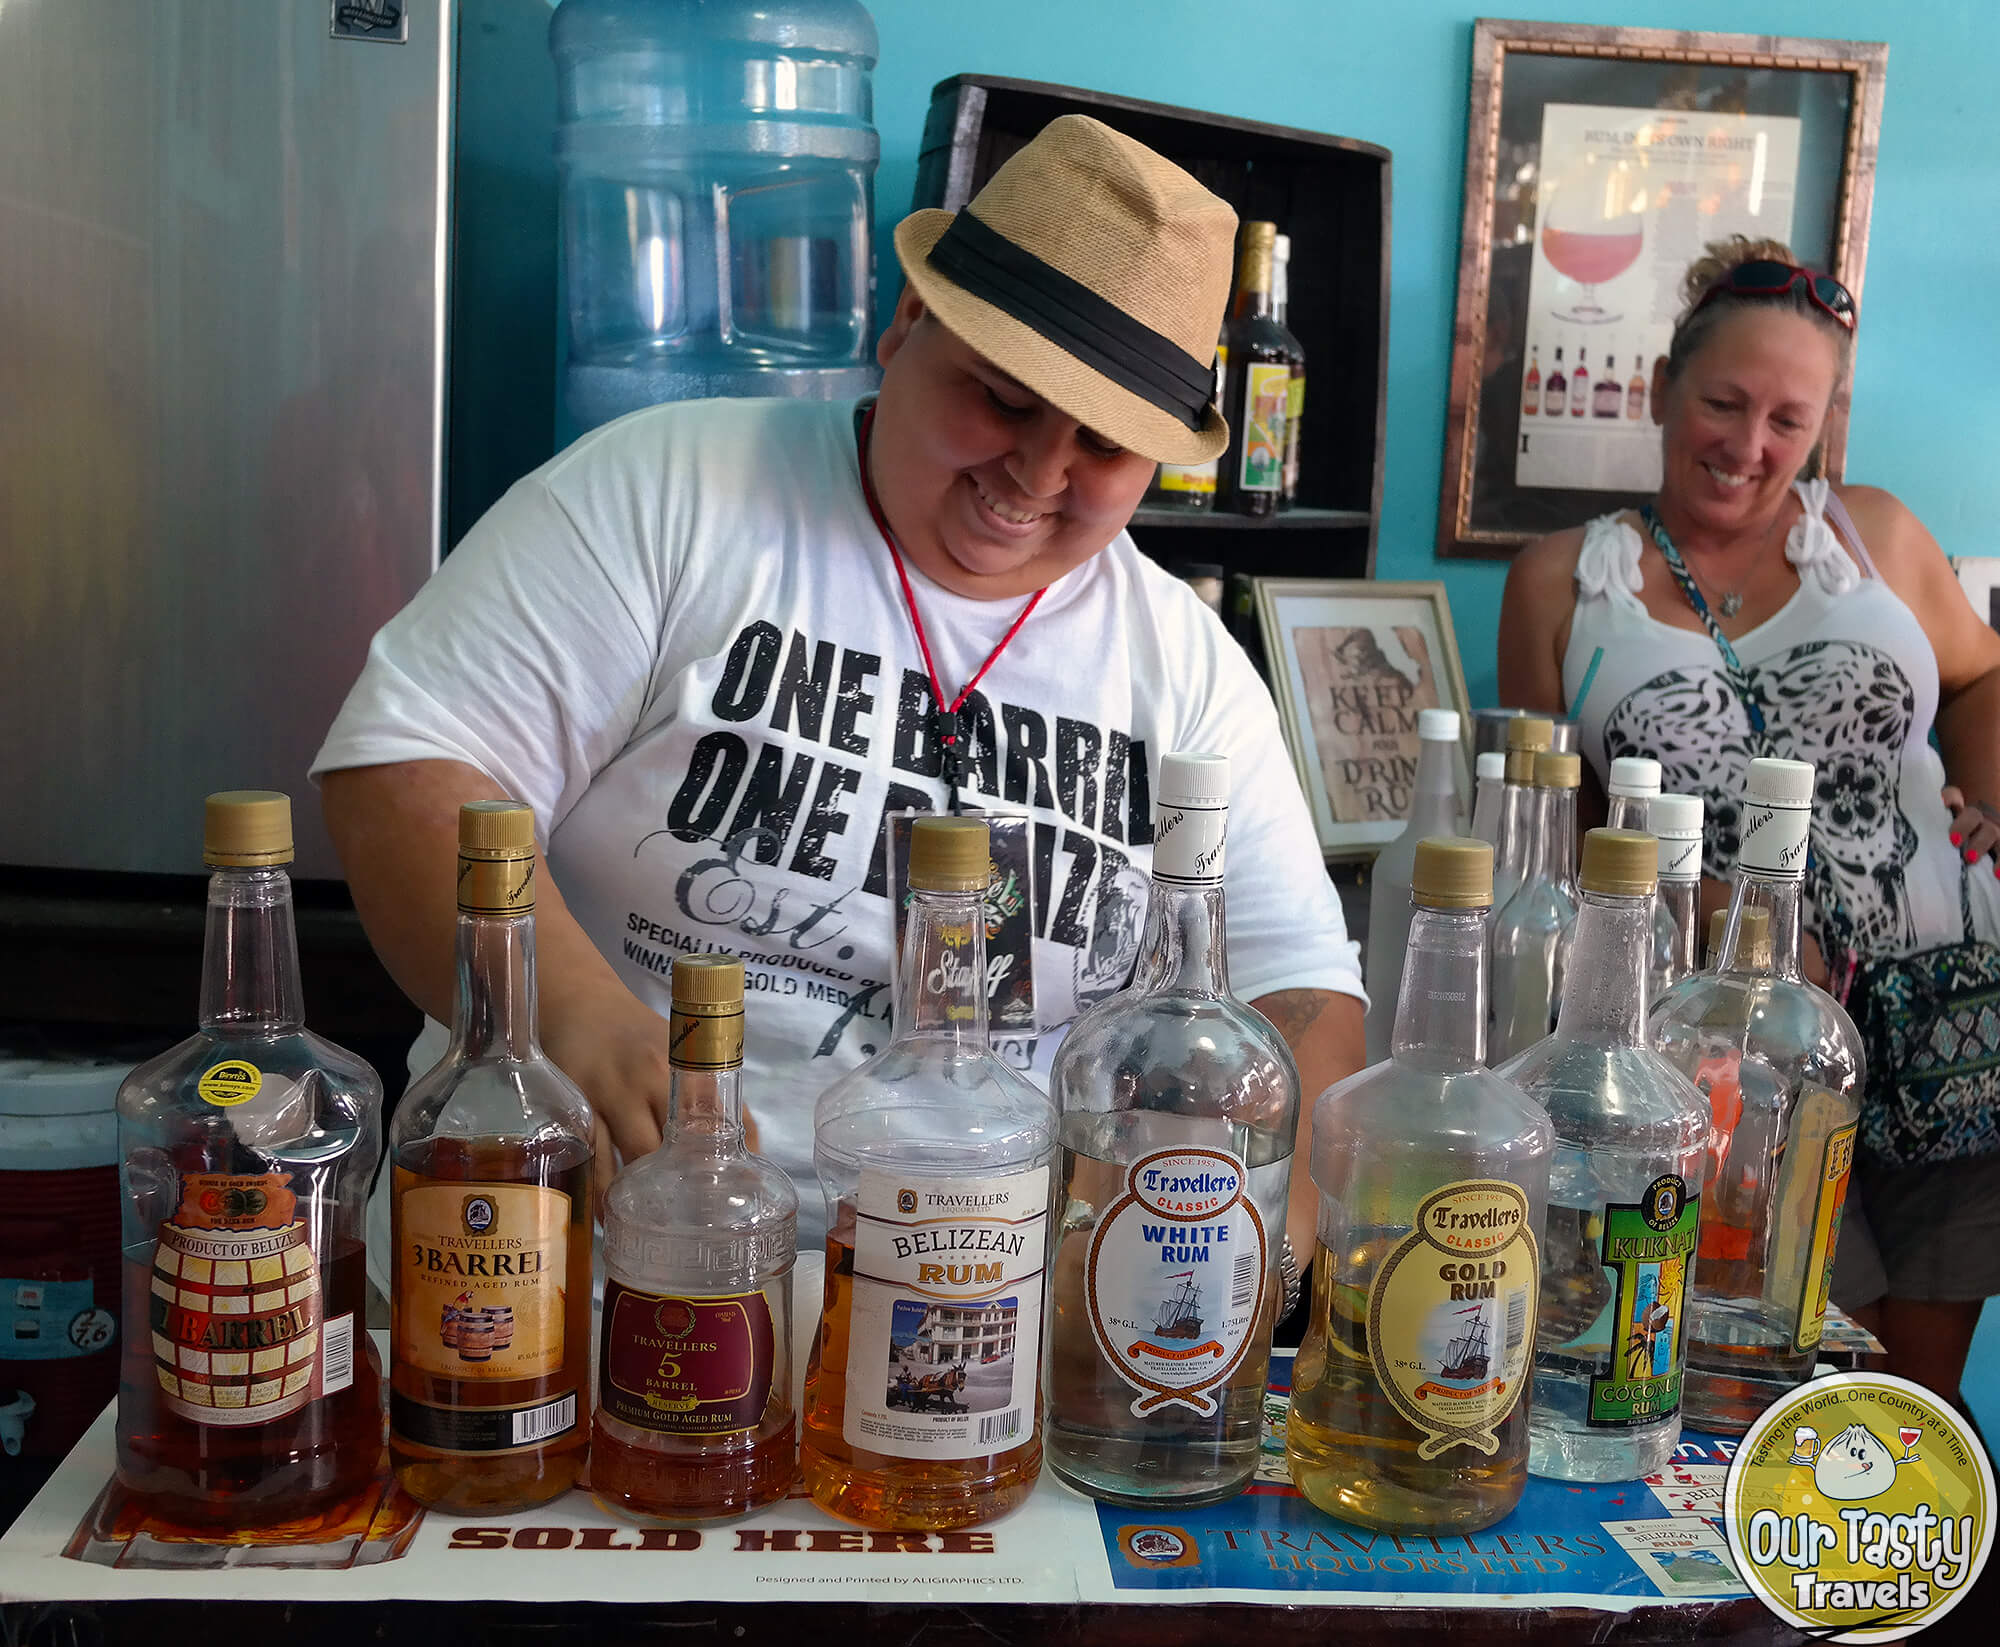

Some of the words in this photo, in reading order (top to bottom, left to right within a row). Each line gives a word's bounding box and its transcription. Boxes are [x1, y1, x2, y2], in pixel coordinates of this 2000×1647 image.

[711, 619, 881, 757] ONE
[1329, 685, 1414, 710] KEEP
[1334, 707, 1419, 735] CALM
[1336, 757, 1419, 786] DRIN
[667, 731, 863, 882] ONE
[1354, 784, 1411, 820] RU
[738, 950, 852, 981] PRODUCED
[744, 971, 798, 995] GOLD
[1162, 1158, 1194, 1168] SINCE
[1143, 1169, 1238, 1194] Travellers
[925, 1191, 1010, 1207] TRAVELLERS
[1157, 1197, 1219, 1212] CLASSIC
[1452, 1194, 1482, 1204] SINCE
[1433, 1206, 1520, 1230] Travellers
[172, 1234, 230, 1256] PRODUCT
[231, 1244, 248, 1256] OF
[252, 1232, 296, 1255] BELIZE
[438, 1235, 523, 1250] TRAVELLERS
[892, 1229, 1026, 1259] BELIZEAN
[1141, 1224, 1229, 1244] WHITE
[1446, 1231, 1505, 1248] CLASSIC
[1612, 1227, 1695, 1259] KUKNAT
[1161, 1246, 1210, 1263] RUM
[421, 1274, 468, 1288] REFINED
[474, 1280, 508, 1289] AGED
[514, 1278, 540, 1288] RUM
[917, 1261, 1005, 1285] RUM
[1439, 1260, 1507, 1282] GOLD
[1450, 1280, 1496, 1301] RUM
[178, 1306, 314, 1350] BARREL
[632, 1335, 717, 1352] TRAVELLERS
[657, 1352, 682, 1378] 5
[646, 1378, 698, 1391] BARREL
[1601, 1375, 1680, 1403] COCONUT
[616, 1400, 650, 1419] PREMIUM
[652, 1411, 679, 1423] GOLD
[682, 1413, 708, 1424] AGED
[711, 1413, 732, 1423] RUM
[1632, 1399, 1660, 1415] RUM
[448, 1526, 703, 1552] SOLD
[733, 1528, 996, 1554] HERE
[1205, 1529, 1607, 1557] TRAVELLERS
[1267, 1554, 1469, 1576] LIQUORS
[755, 1575, 815, 1584] Designed
[818, 1575, 842, 1584] and
[845, 1575, 890, 1584] Printed
[893, 1576, 909, 1586] by
[912, 1576, 996, 1585] ALIGRAPHICS
